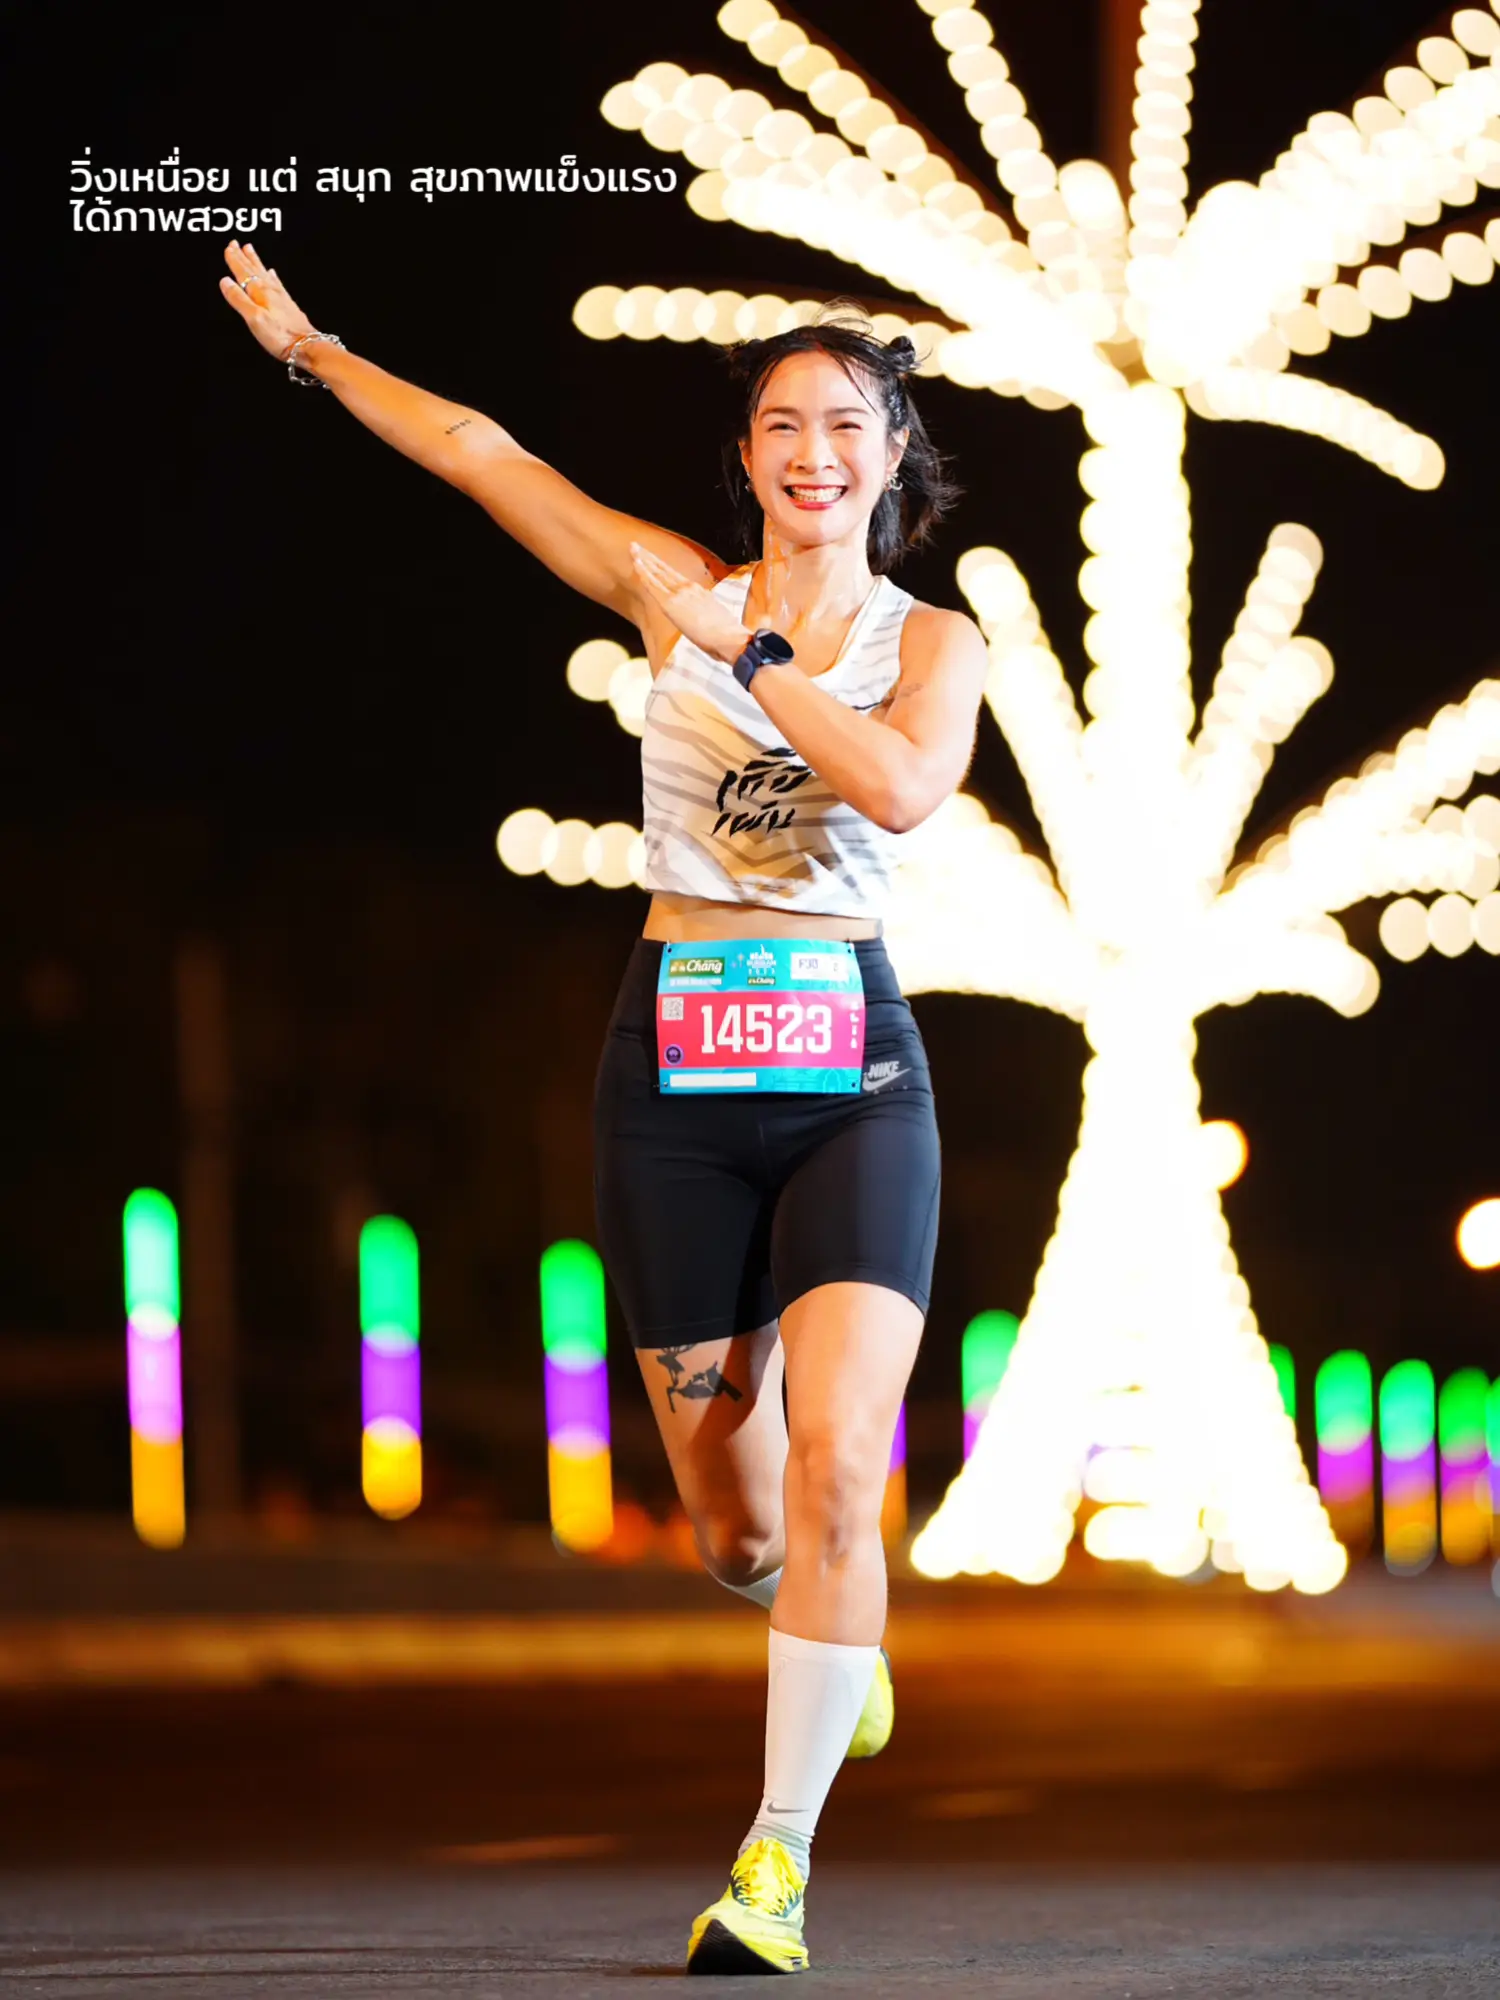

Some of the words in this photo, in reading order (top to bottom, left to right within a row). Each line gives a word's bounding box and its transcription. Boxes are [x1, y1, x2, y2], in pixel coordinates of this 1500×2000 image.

[687, 959, 723, 974] Chang
[701, 1004, 832, 1054] 14523
[868, 1060, 900, 1079] NIKE
